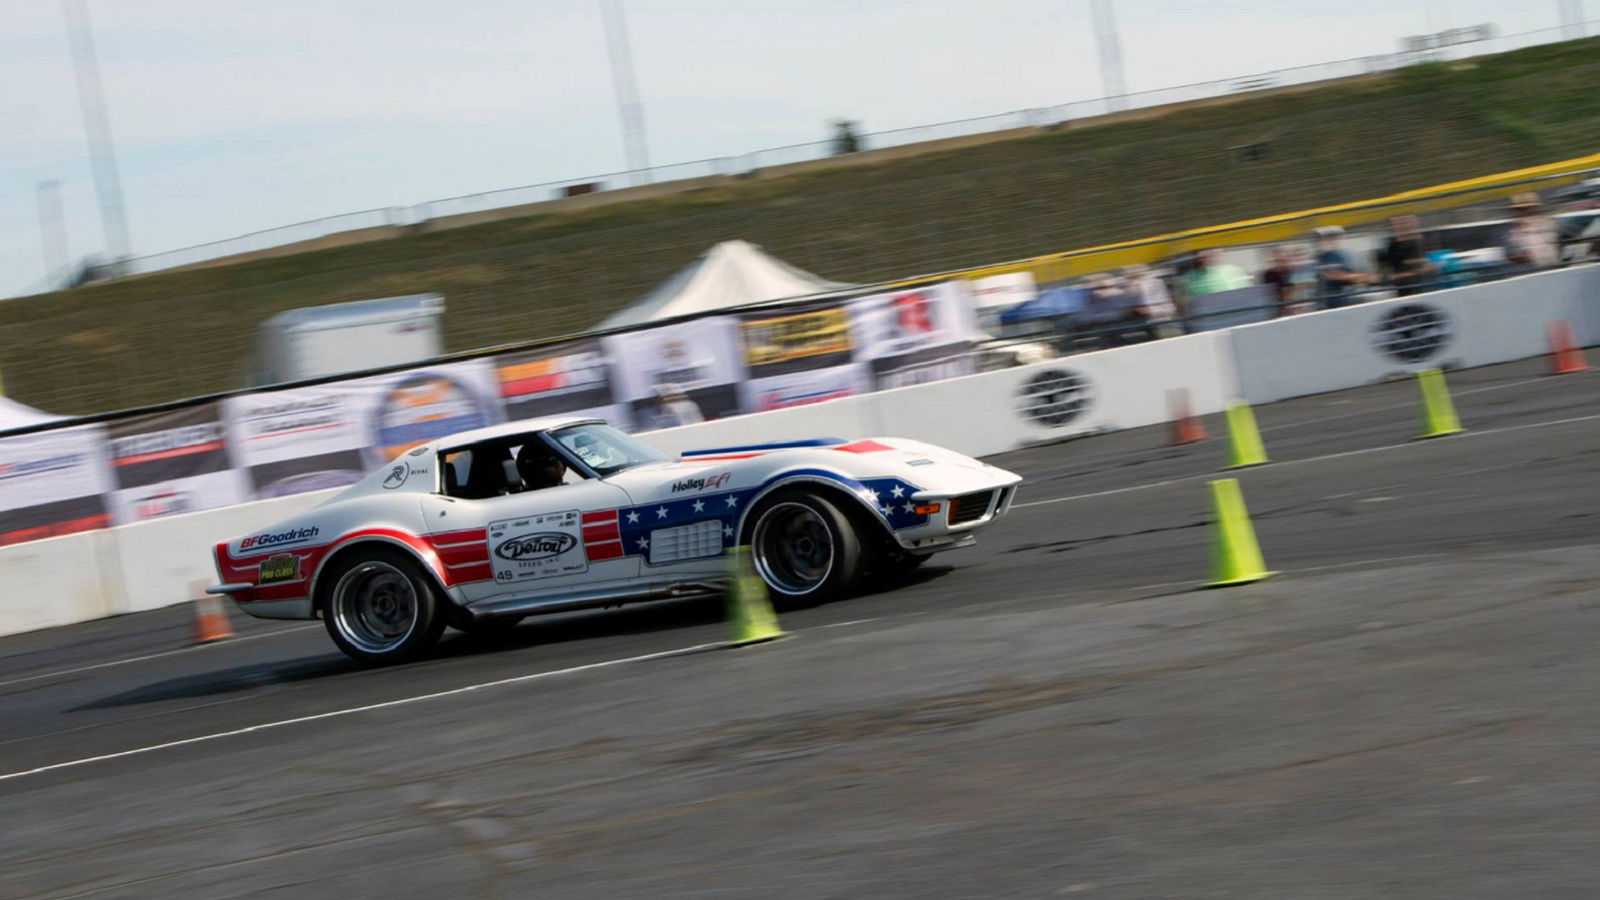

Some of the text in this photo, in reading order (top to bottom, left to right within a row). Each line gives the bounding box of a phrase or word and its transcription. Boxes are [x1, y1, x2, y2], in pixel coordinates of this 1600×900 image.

[672, 478, 705, 492] Holley
[241, 526, 319, 548] BFGoodrich
[497, 570, 513, 580] 49
